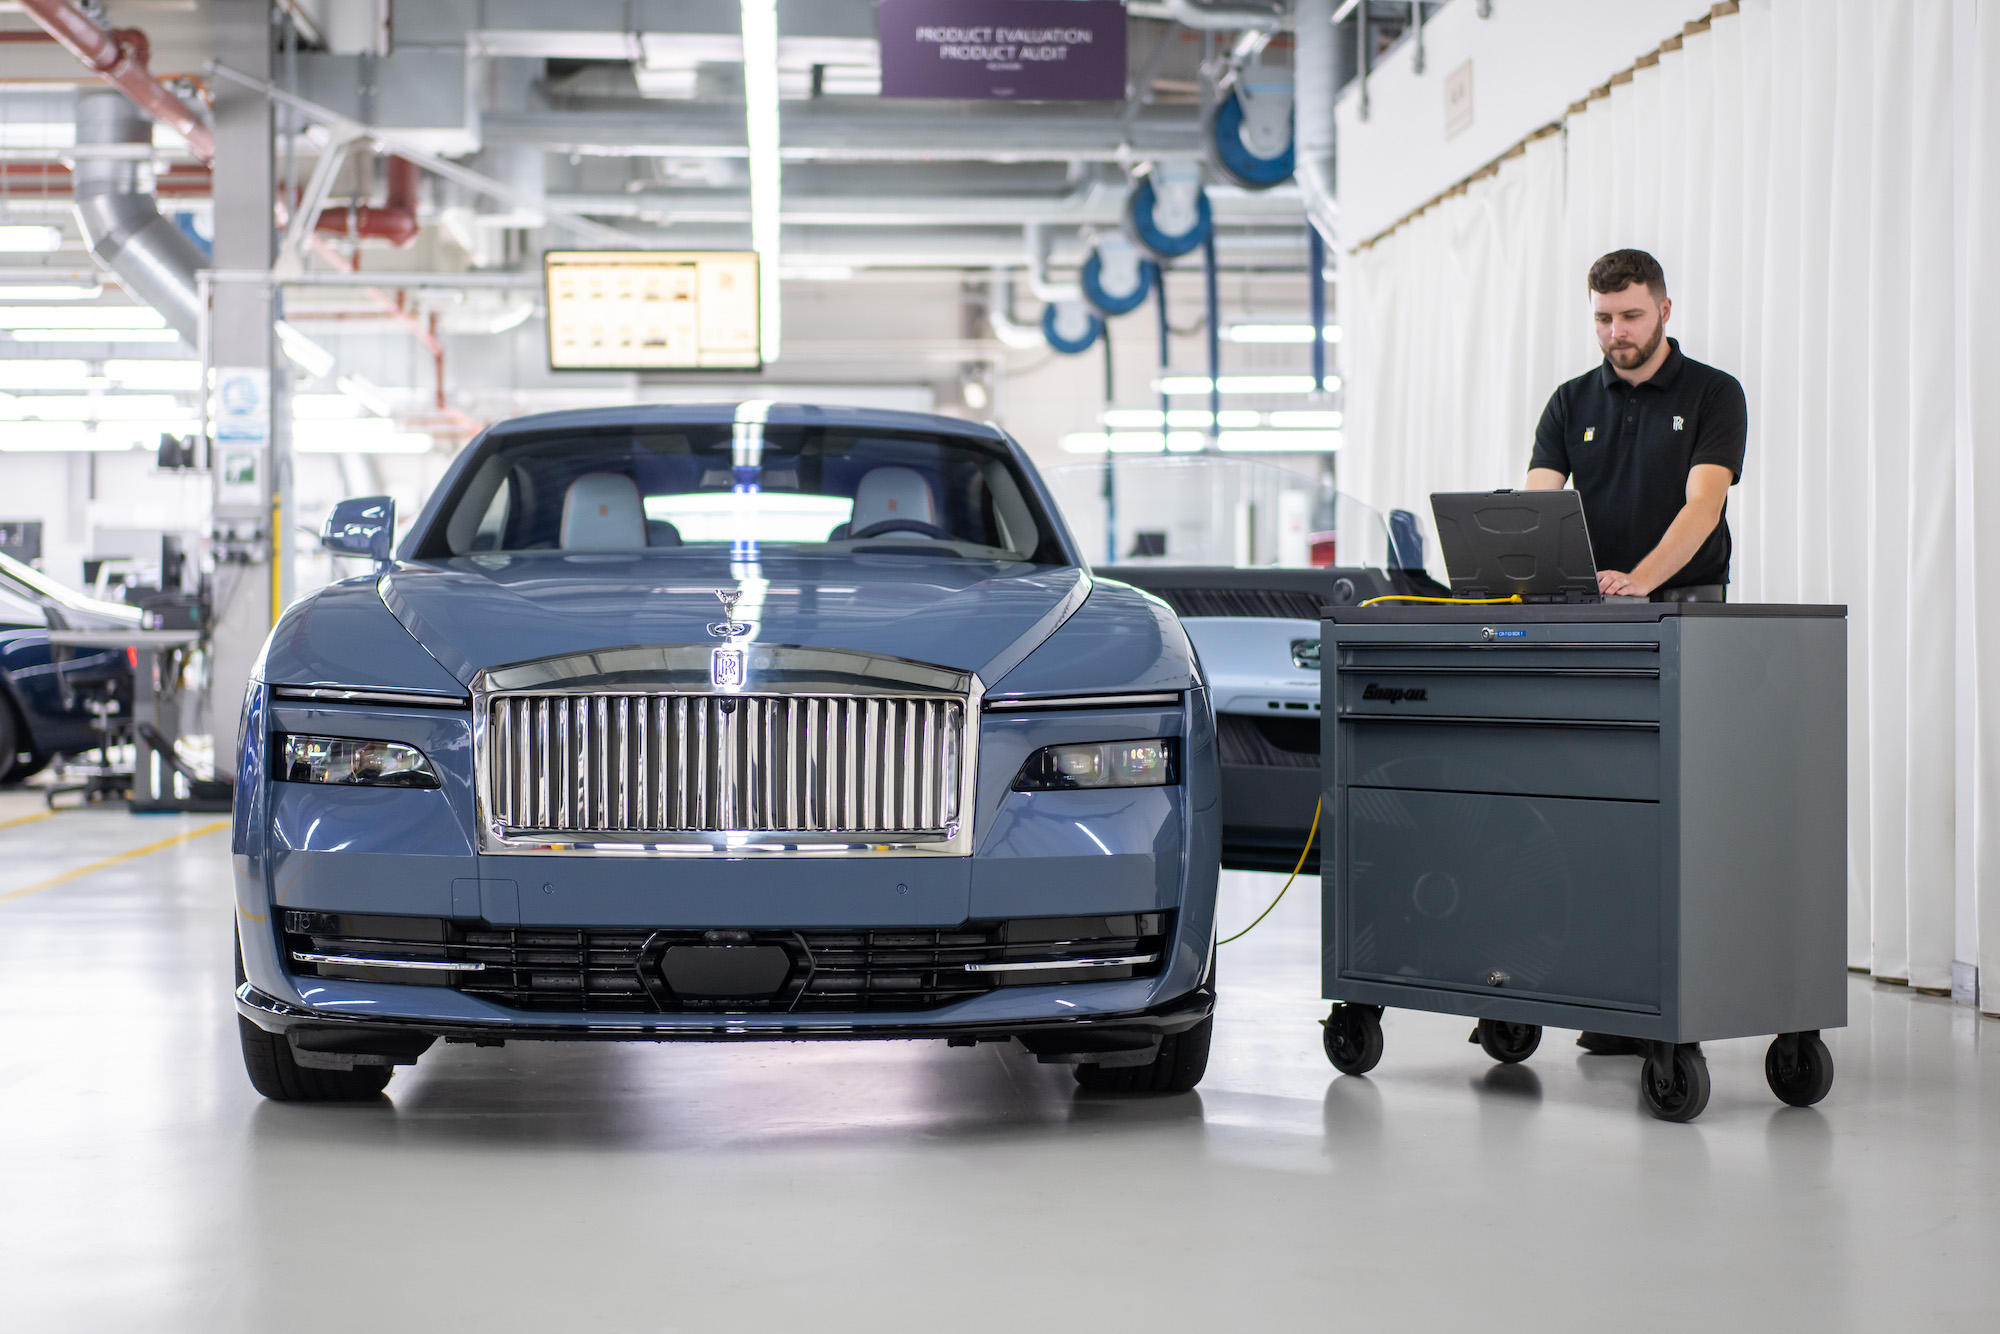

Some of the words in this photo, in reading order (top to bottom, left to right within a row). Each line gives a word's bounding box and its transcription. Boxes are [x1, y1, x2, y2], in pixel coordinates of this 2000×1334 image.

[915, 26, 992, 43] PRODUCT
[995, 27, 1093, 44] EVALUATION
[939, 44, 1016, 60] PRODUCT
[1018, 45, 1068, 61] AUDIT
